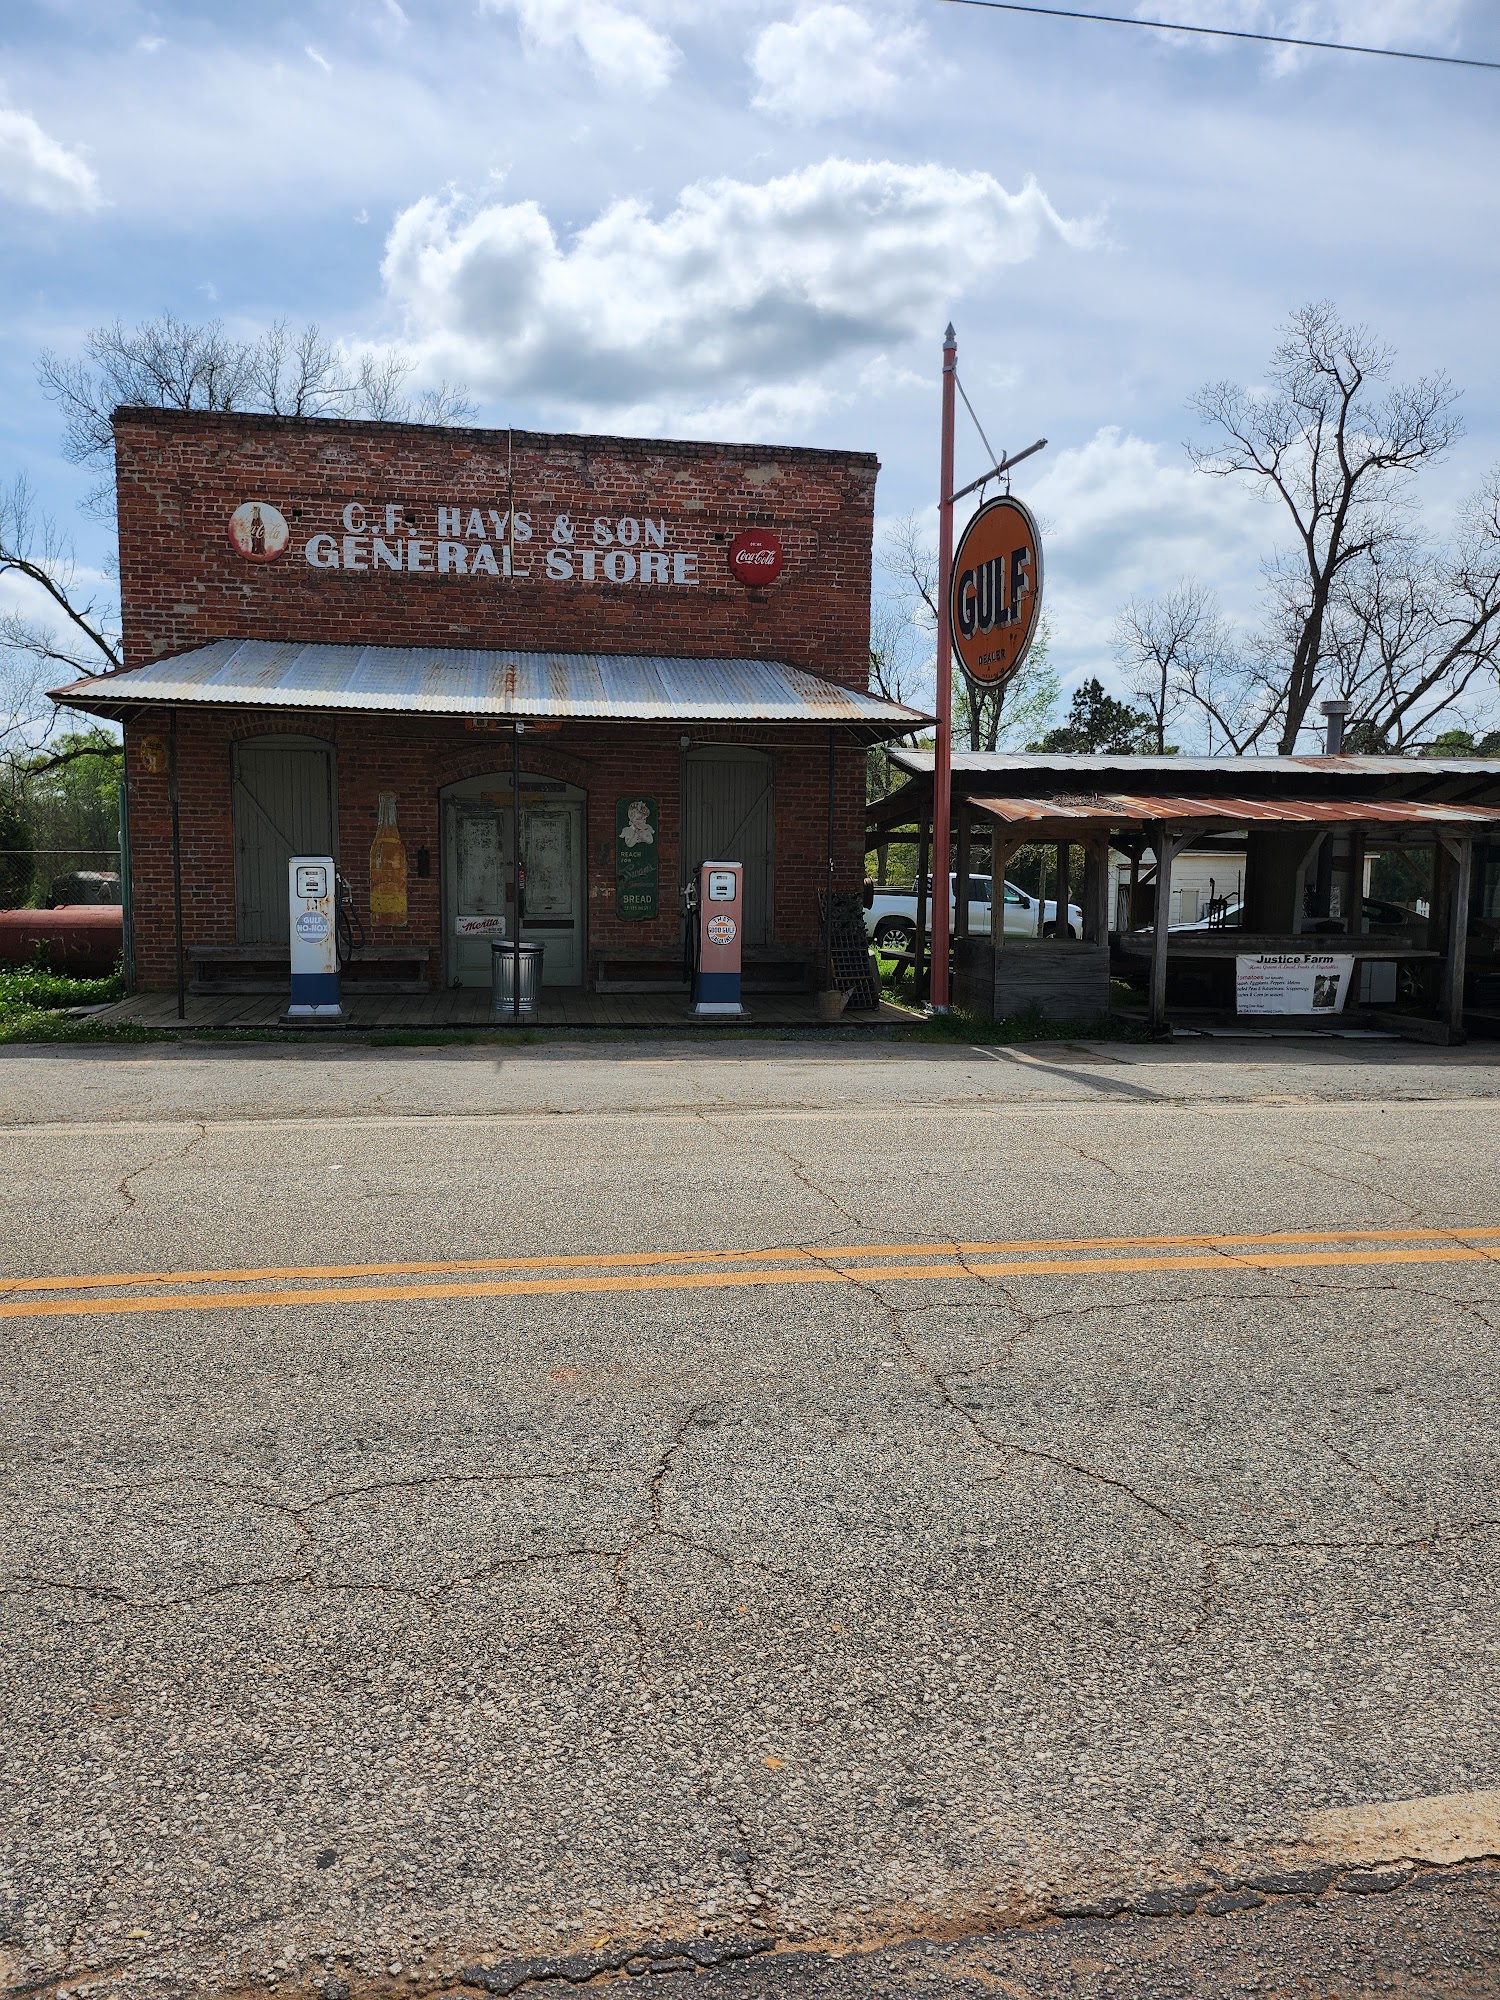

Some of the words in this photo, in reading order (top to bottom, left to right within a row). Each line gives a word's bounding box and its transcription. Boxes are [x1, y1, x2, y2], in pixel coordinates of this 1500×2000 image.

[343, 502, 418, 536] C.F.
[438, 507, 533, 541] HAYS
[552, 514, 575, 544] &
[593, 516, 666, 548] SON
[305, 535, 530, 577] GENERAL
[546, 548, 700, 585] STORE
[735, 549, 777, 565] Coca-Cola
[957, 546, 1031, 641] GULF
[978, 648, 1006, 666] DEALER
[623, 895, 652, 904] BREAD
[303, 916, 323, 924] GULF
[297, 924, 328, 932] NO-NOX
[722, 926, 735, 934] GULF
[1256, 954, 1301, 964] Justice
[1303, 954, 1334, 964] Farm
